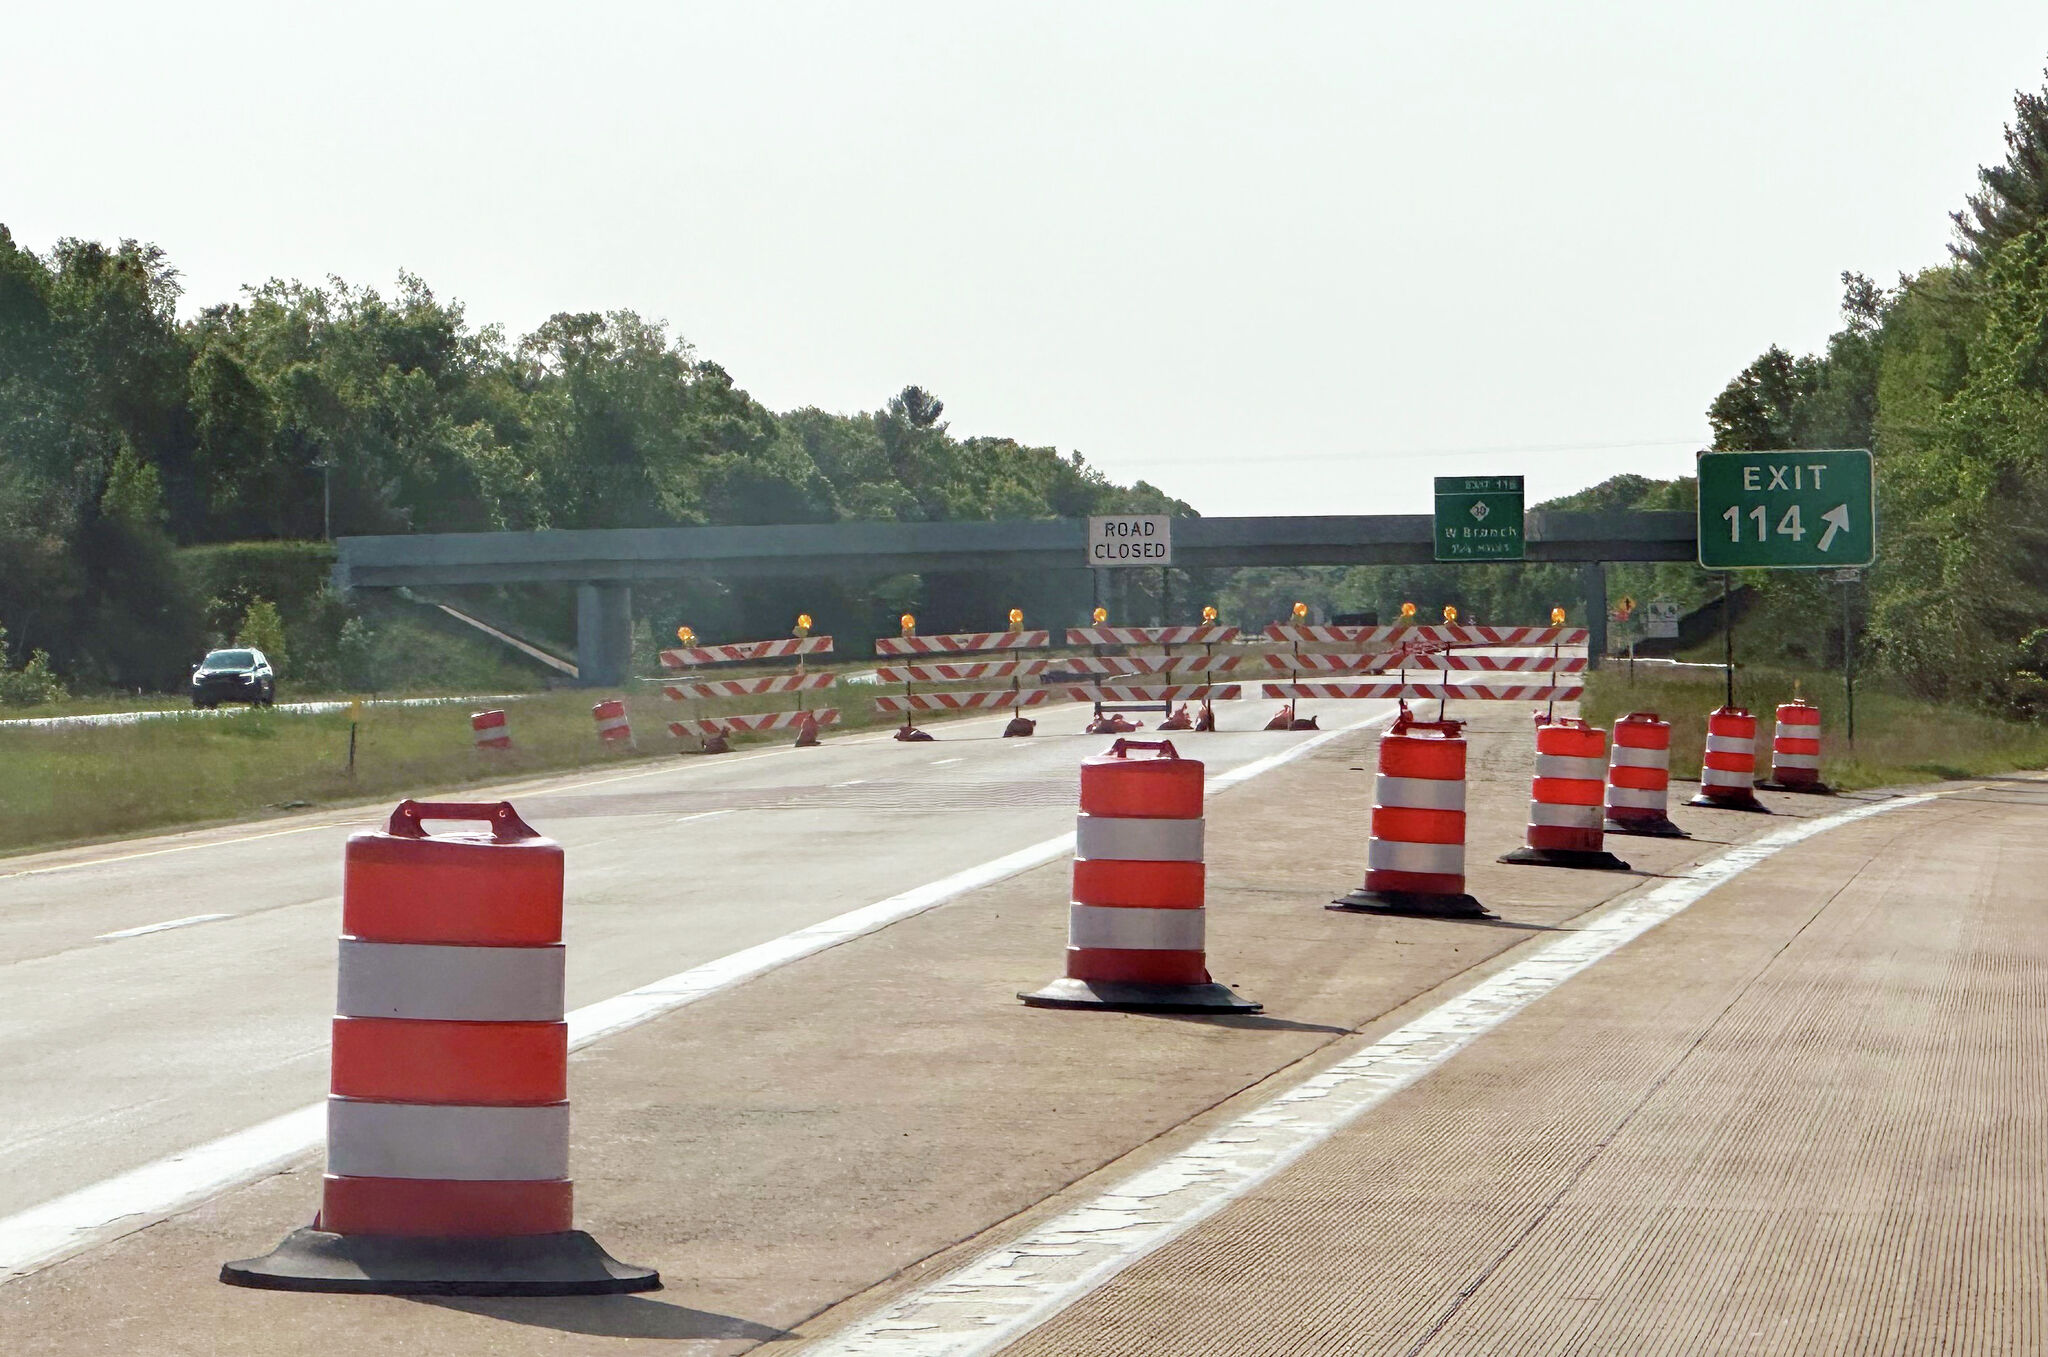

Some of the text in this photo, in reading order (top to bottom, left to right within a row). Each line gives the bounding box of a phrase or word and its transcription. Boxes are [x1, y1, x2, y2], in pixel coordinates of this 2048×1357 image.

[1744, 465, 1827, 491] EXIT
[1104, 521, 1155, 537] ROAD
[1445, 526, 1517, 538] W Branch
[1722, 505, 1807, 543] 114
[1094, 543, 1166, 559] CLOSED
